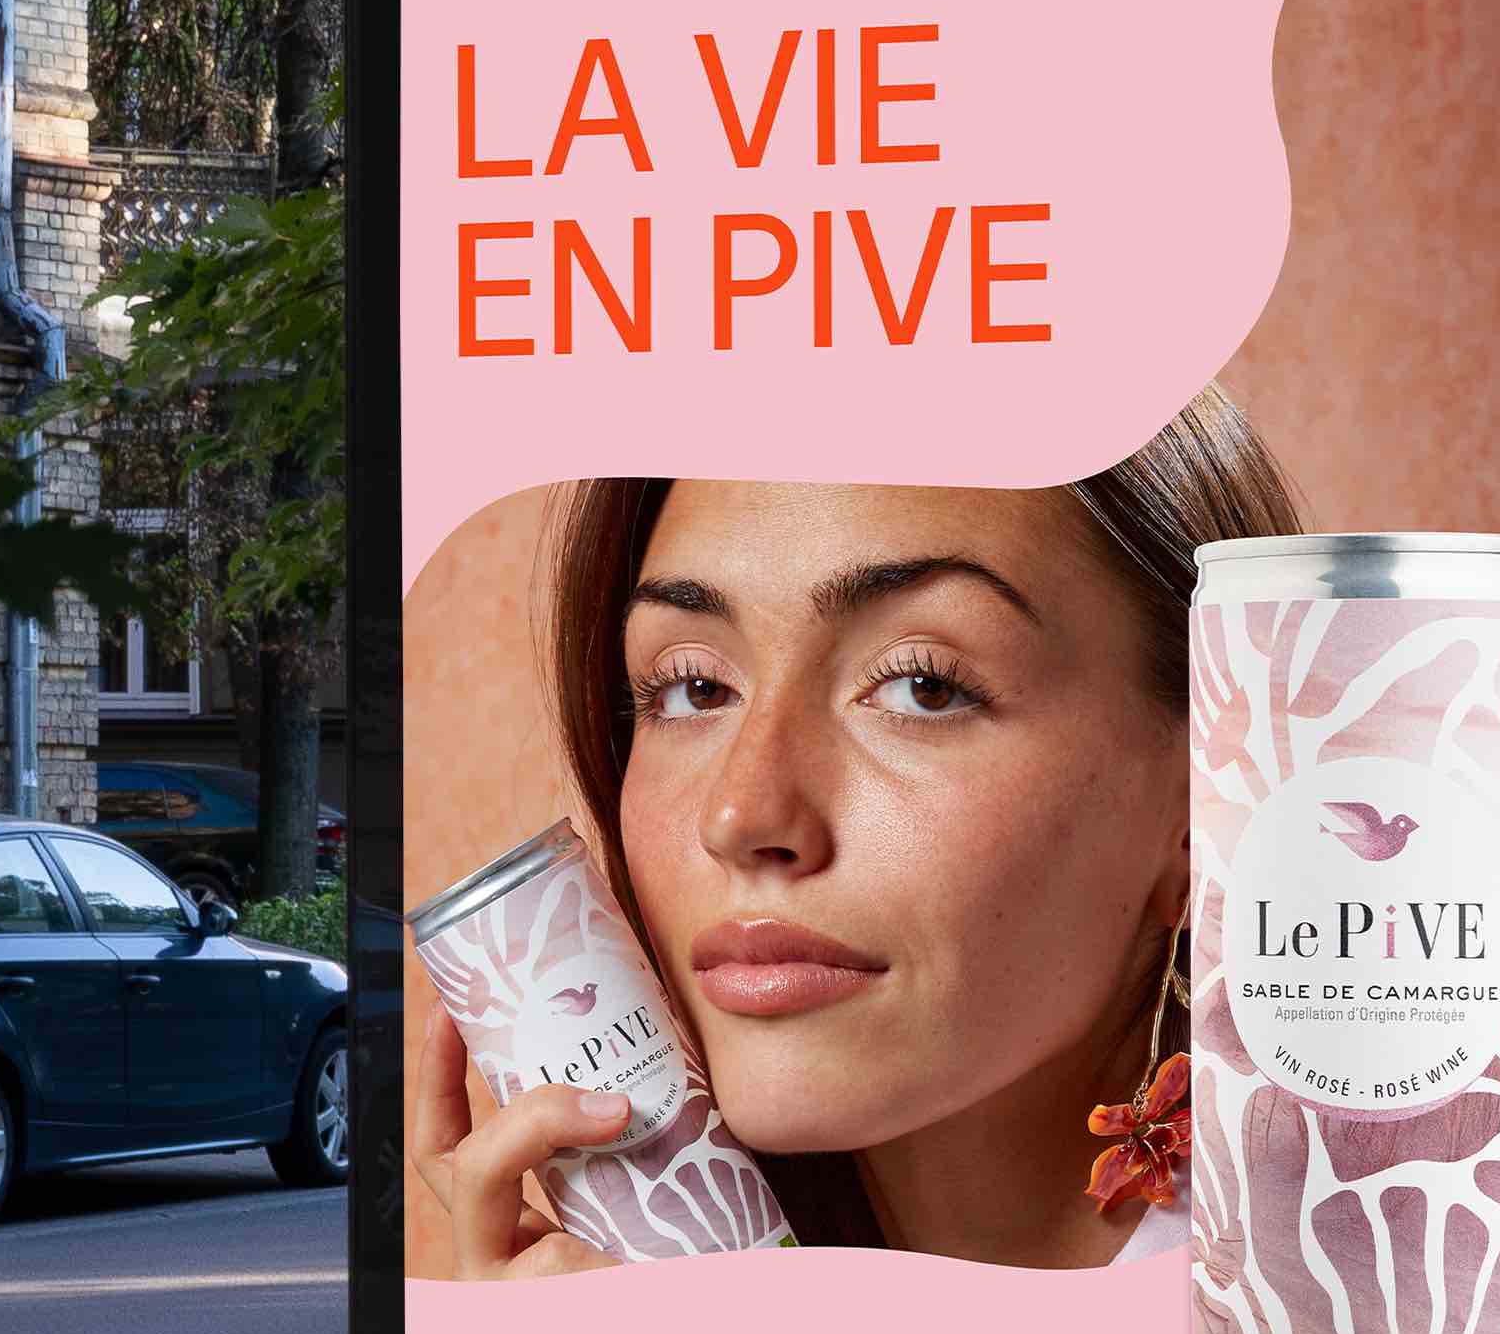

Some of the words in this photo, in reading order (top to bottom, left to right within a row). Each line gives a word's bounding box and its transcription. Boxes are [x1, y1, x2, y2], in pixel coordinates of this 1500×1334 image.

[456, 38, 654, 179] LA
[693, 24, 941, 169] VIE
[457, 217, 653, 357] EN
[712, 203, 1053, 351] PIVE
[1255, 900, 1320, 959] Le
[1334, 900, 1486, 961] PiVE
[1242, 982, 1311, 1000] SABLE
[1323, 984, 1355, 1000] DE
[1367, 984, 1500, 1001] CAMARGUE
[1274, 1005, 1344, 1022] Appellation
[1347, 1006, 1407, 1024] d'Origine
[1409, 1007, 1466, 1025] Protégée
[580, 1005, 659, 1071] PiVE
[615, 1042, 675, 1083] CAMARGUE
[1274, 1044, 1301, 1075] VIN
[1304, 1069, 1352, 1098] ROSÉ
[1373, 1072, 1422, 1099] ROSÉ
[1425, 1045, 1470, 1085] WINE
